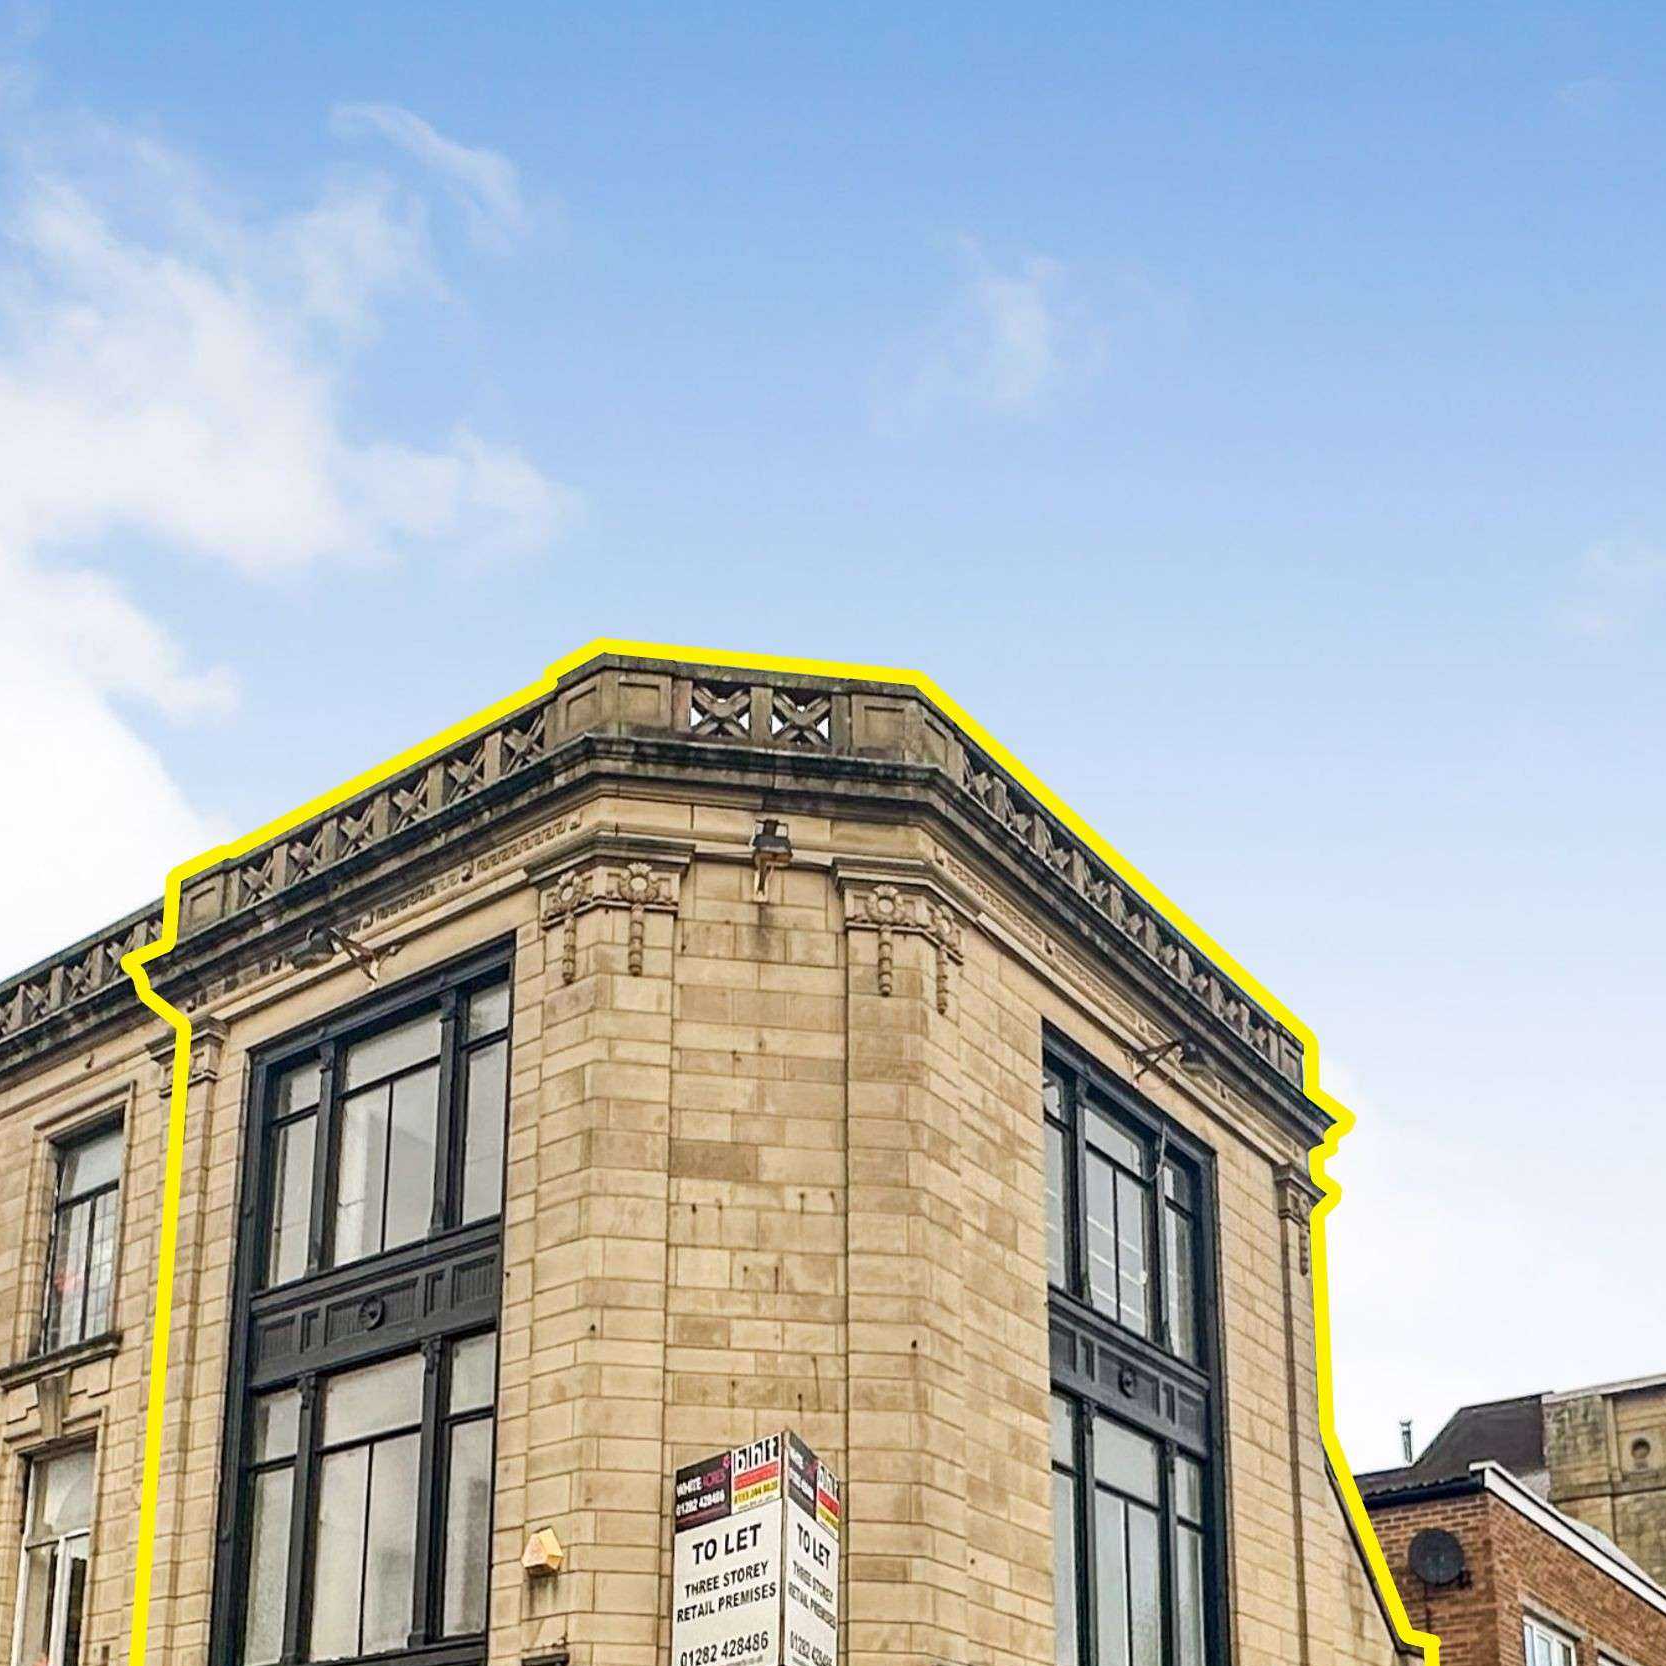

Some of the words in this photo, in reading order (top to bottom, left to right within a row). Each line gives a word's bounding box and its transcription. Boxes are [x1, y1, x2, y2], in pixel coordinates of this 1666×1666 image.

[692, 1538, 717, 1565] TO
[724, 1523, 762, 1557] LET
[797, 1523, 811, 1554] TO
[812, 1536, 831, 1571] LET
[685, 1575, 720, 1600] THREE
[723, 1560, 770, 1588] STOREY
[677, 1602, 715, 1624] RETAIL
[718, 1582, 777, 1613] PREMISES
[721, 1631, 769, 1659] 428486
